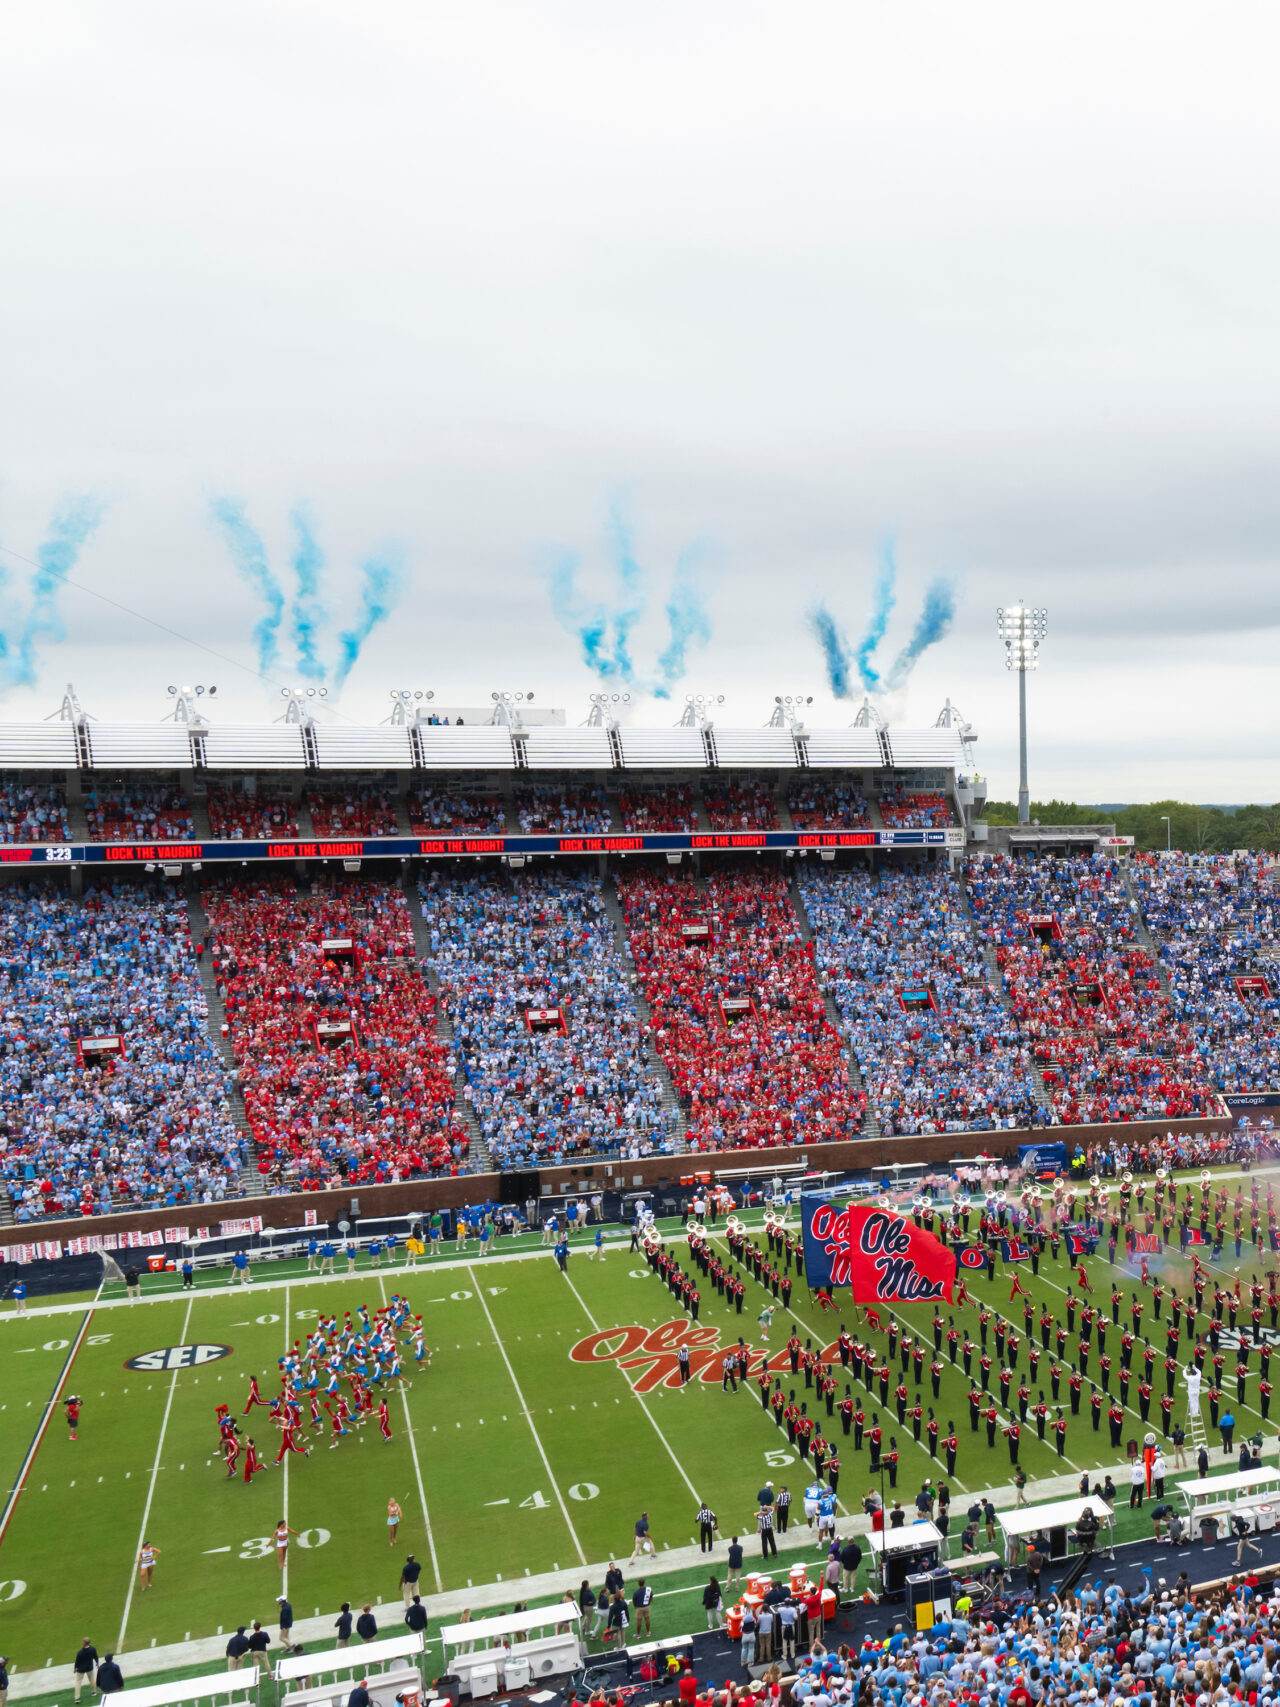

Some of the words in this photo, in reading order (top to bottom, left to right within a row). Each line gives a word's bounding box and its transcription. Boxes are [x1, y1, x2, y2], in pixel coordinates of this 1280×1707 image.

[420, 841, 445, 853] LOCK
[446, 840, 464, 852] THE
[466, 840, 504, 852] VAUGHT!
[560, 840, 584, 851] LOCK
[585, 839, 602, 850] THE
[604, 838, 644, 850] VAUGHT!
[692, 836, 713, 848] LOCK
[714, 836, 730, 846] THE
[731, 835, 767, 846] VAUGHT!
[798, 835, 821, 846] LOCK
[822, 834, 838, 846] THE
[839, 834, 876, 845] VAUGHT!
[46, 848, 72, 861] 3:23
[106, 847, 134, 860] LOCK
[136, 846, 156, 860] THE
[157, 846, 202, 859] VAUGHT!
[268, 844, 296, 858] LOCK
[298, 844, 318, 857] THE
[319, 842, 364, 856] VAUGHT!
[1228, 1097, 1266, 1105] CoreLogic
[860, 1212, 911, 1255] Ole
[1187, 1227, 1206, 1245] I
[1135, 1234, 1159, 1252] M
[960, 1248, 984, 1268] O
[1008, 1242, 1030, 1261] L
[152, 1260, 159, 1268] G
[255, 1309, 319, 1325] 30
[42, 1333, 114, 1352] 20
[569, 1318, 722, 1362] Ole
[134, 1344, 225, 1370] SEC
[518, 1482, 600, 1510] 40
[808, 1490, 818, 1498] 38
[825, 1502, 834, 1511] 71
[238, 1528, 332, 1559] 30
[752, 1580, 757, 1588] G
[408, 1696, 415, 1704] G
